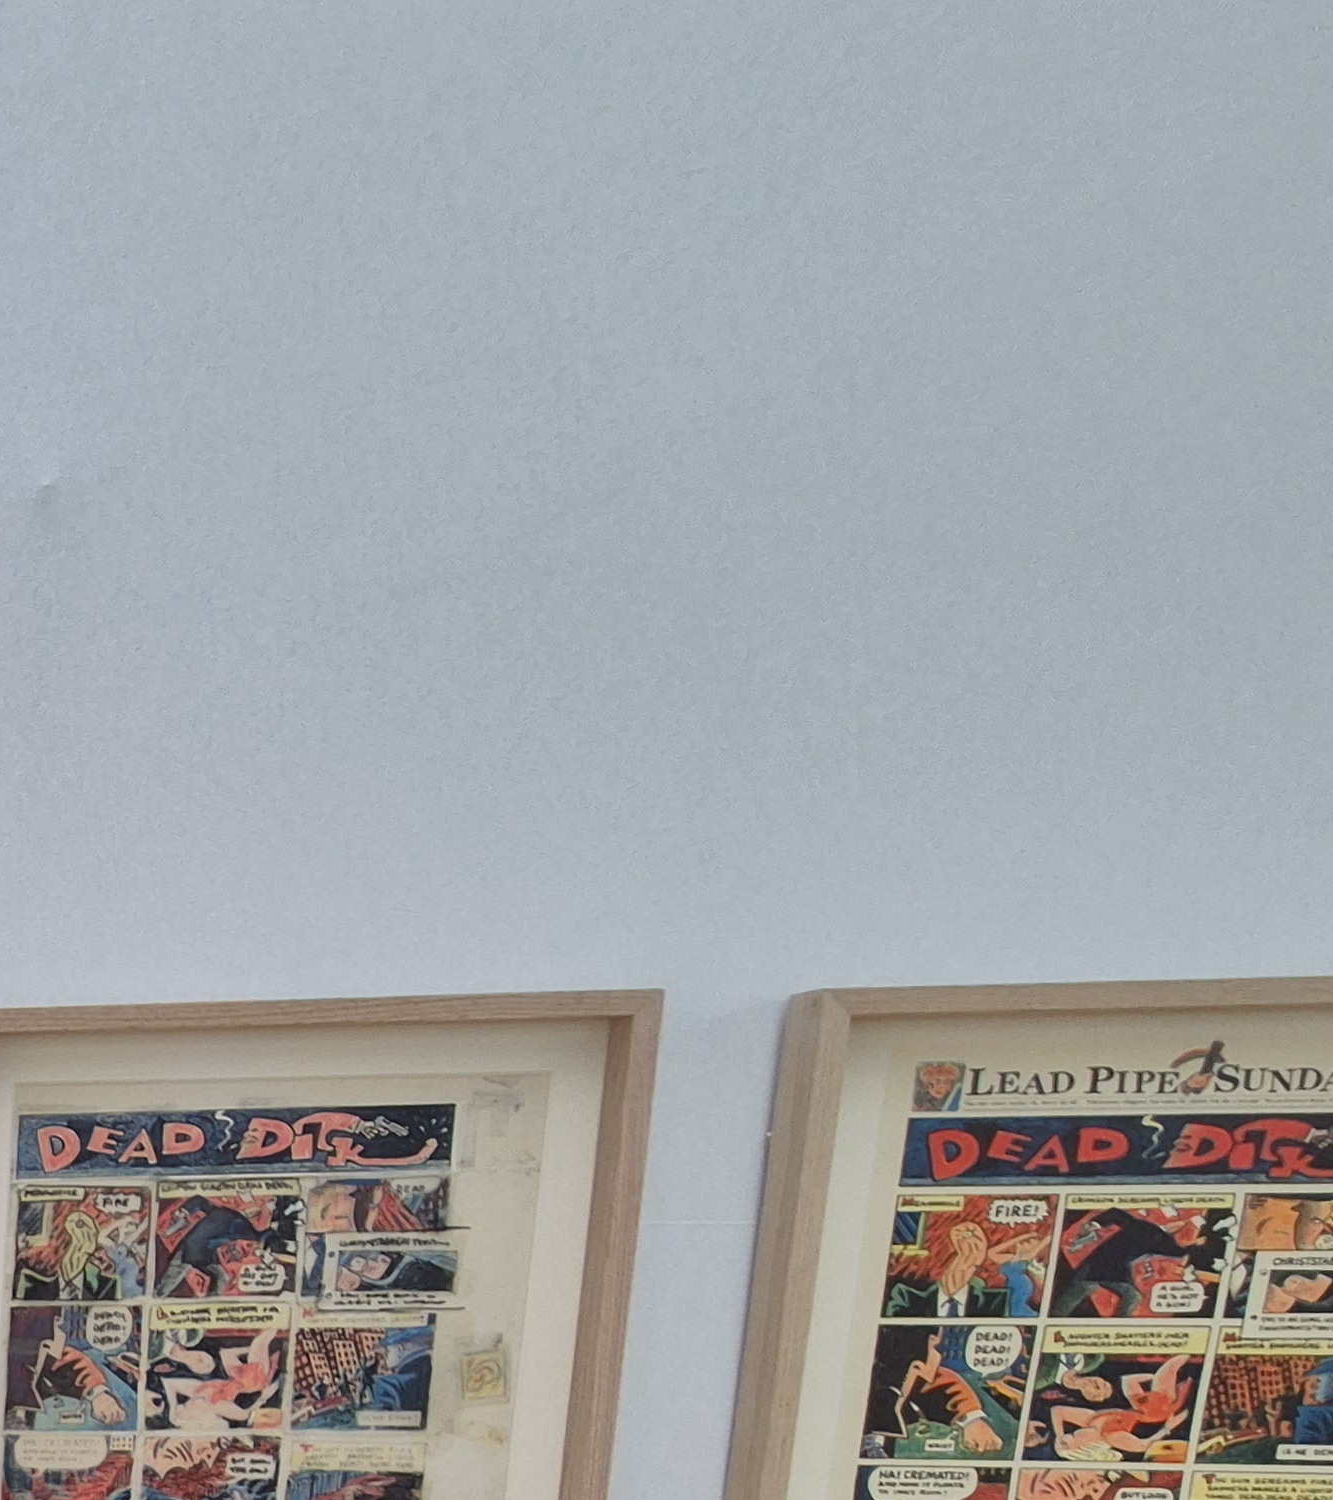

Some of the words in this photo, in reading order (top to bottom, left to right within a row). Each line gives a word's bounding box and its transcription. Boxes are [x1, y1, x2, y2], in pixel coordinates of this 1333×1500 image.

[965, 1067, 1076, 1096] LEAD
[1084, 1065, 1180, 1095] PIPE
[36, 1120, 205, 1173] DEAD
[927, 1126, 1130, 1181] DEAD
[994, 1204, 1040, 1218] FIRE!
[976, 1331, 1013, 1342] DEAD!
[974, 1344, 1011, 1354] DEAD!
[973, 1357, 1009, 1367] DEAD!
[904, 1470, 970, 1481] CREMATED!
